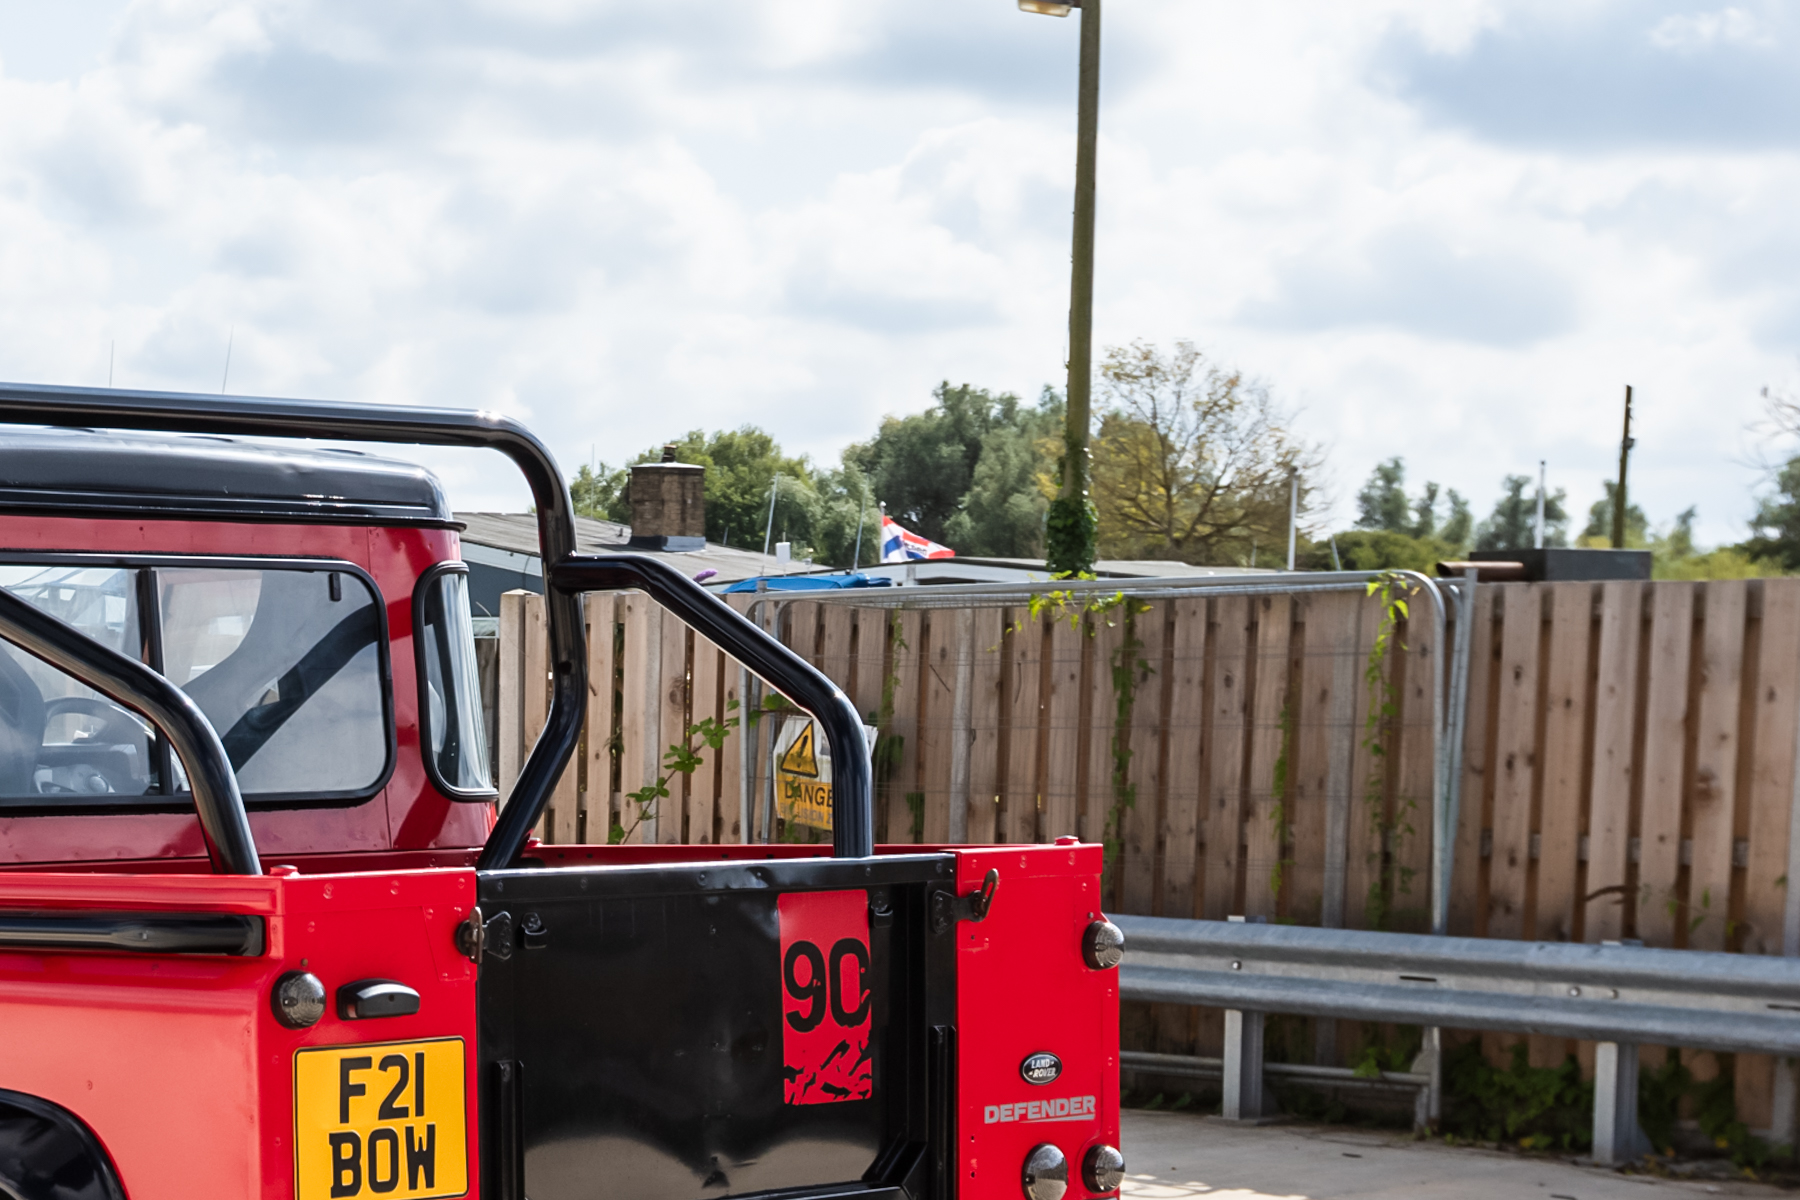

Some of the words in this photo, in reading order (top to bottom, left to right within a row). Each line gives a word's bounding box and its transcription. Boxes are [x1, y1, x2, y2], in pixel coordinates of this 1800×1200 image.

[785, 780, 832, 807] DANGE
[783, 937, 873, 1033] 90
[1030, 1058, 1051, 1069] LAND
[1032, 1067, 1057, 1078] ROVER
[339, 1052, 425, 1124] F21
[984, 1095, 1096, 1124] DEFENDER
[328, 1124, 436, 1199] BOW
